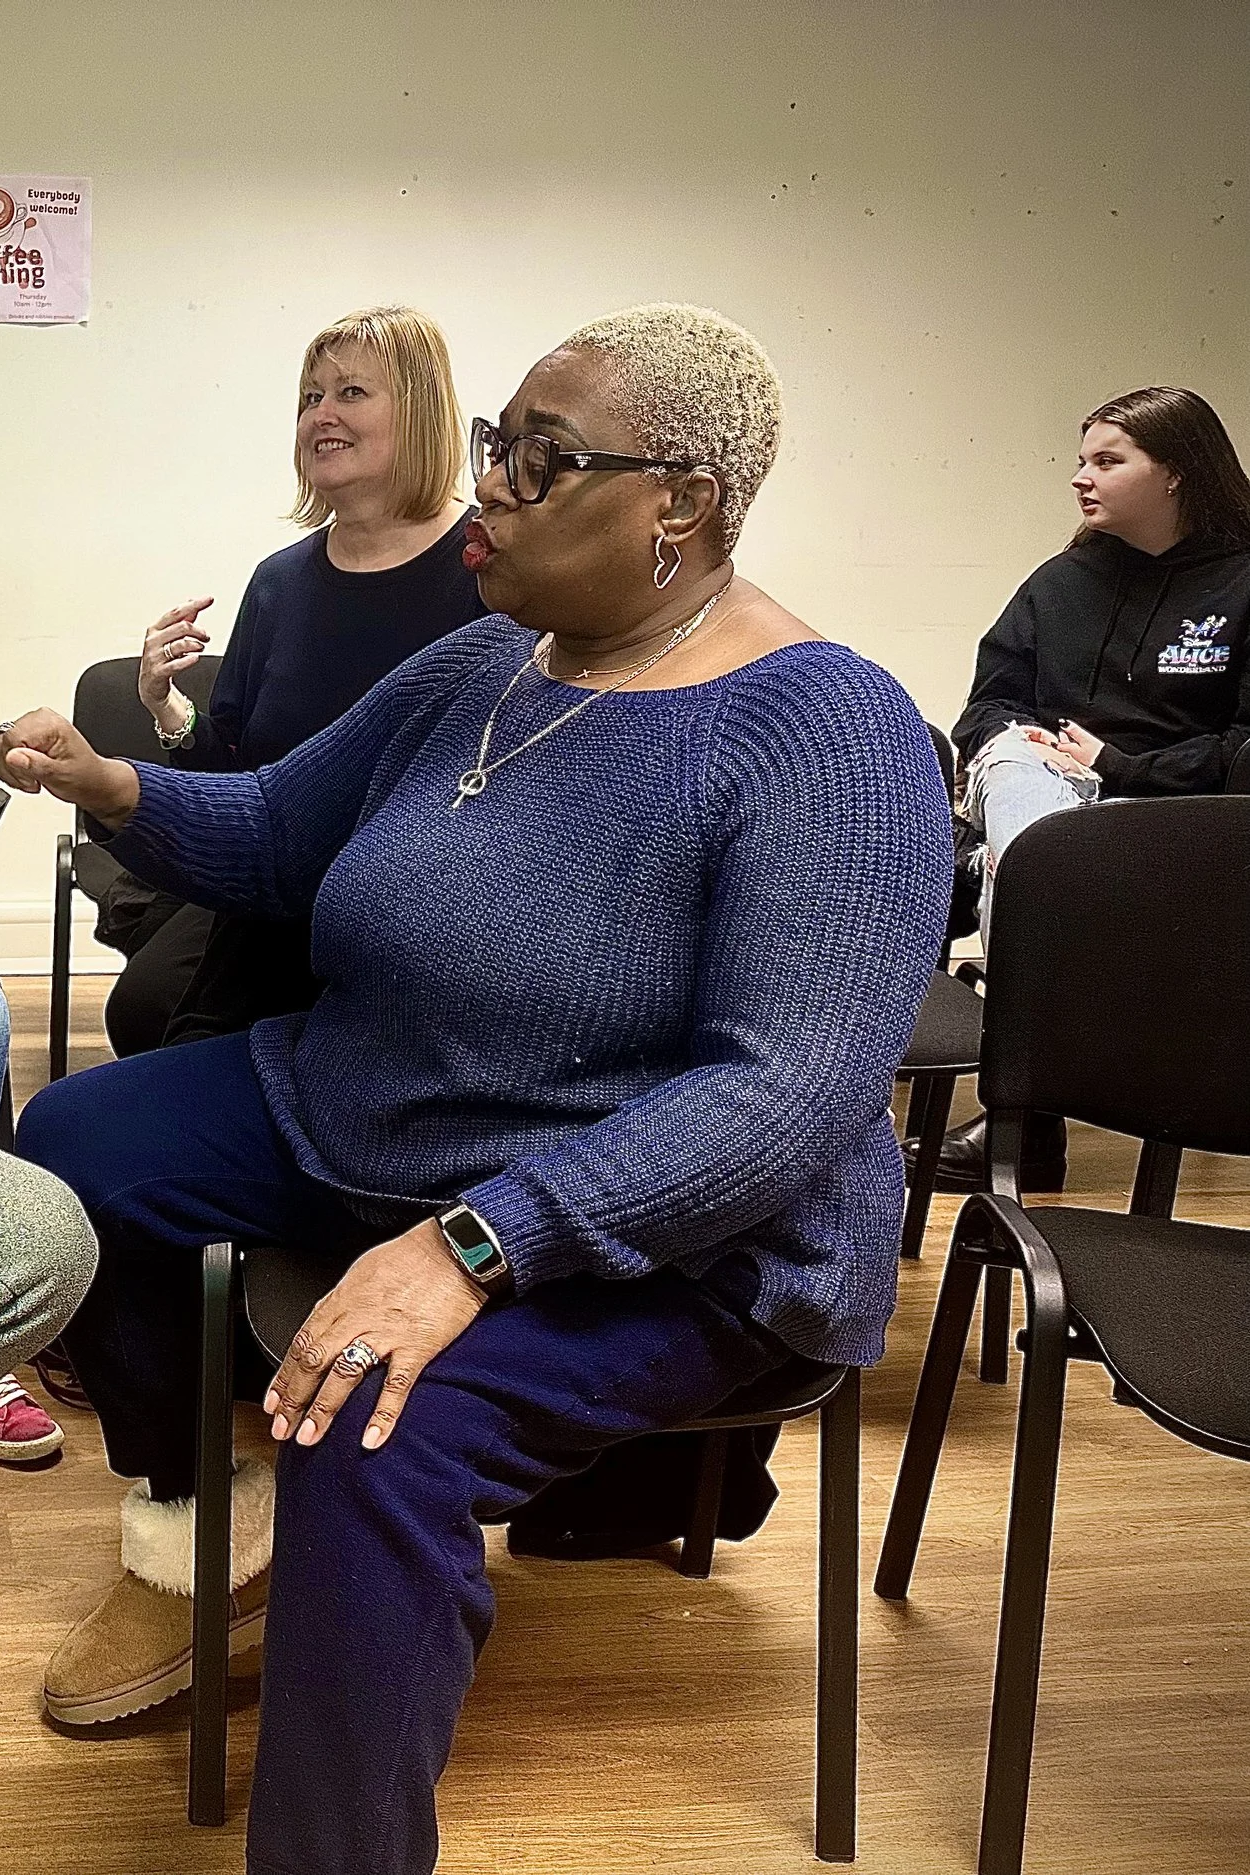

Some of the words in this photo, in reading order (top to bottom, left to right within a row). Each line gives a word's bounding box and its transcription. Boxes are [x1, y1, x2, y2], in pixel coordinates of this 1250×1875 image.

[28, 189, 80, 203] Everybody
[30, 204, 78, 215] welcome!
[1158, 645, 1230, 664] ALICE
